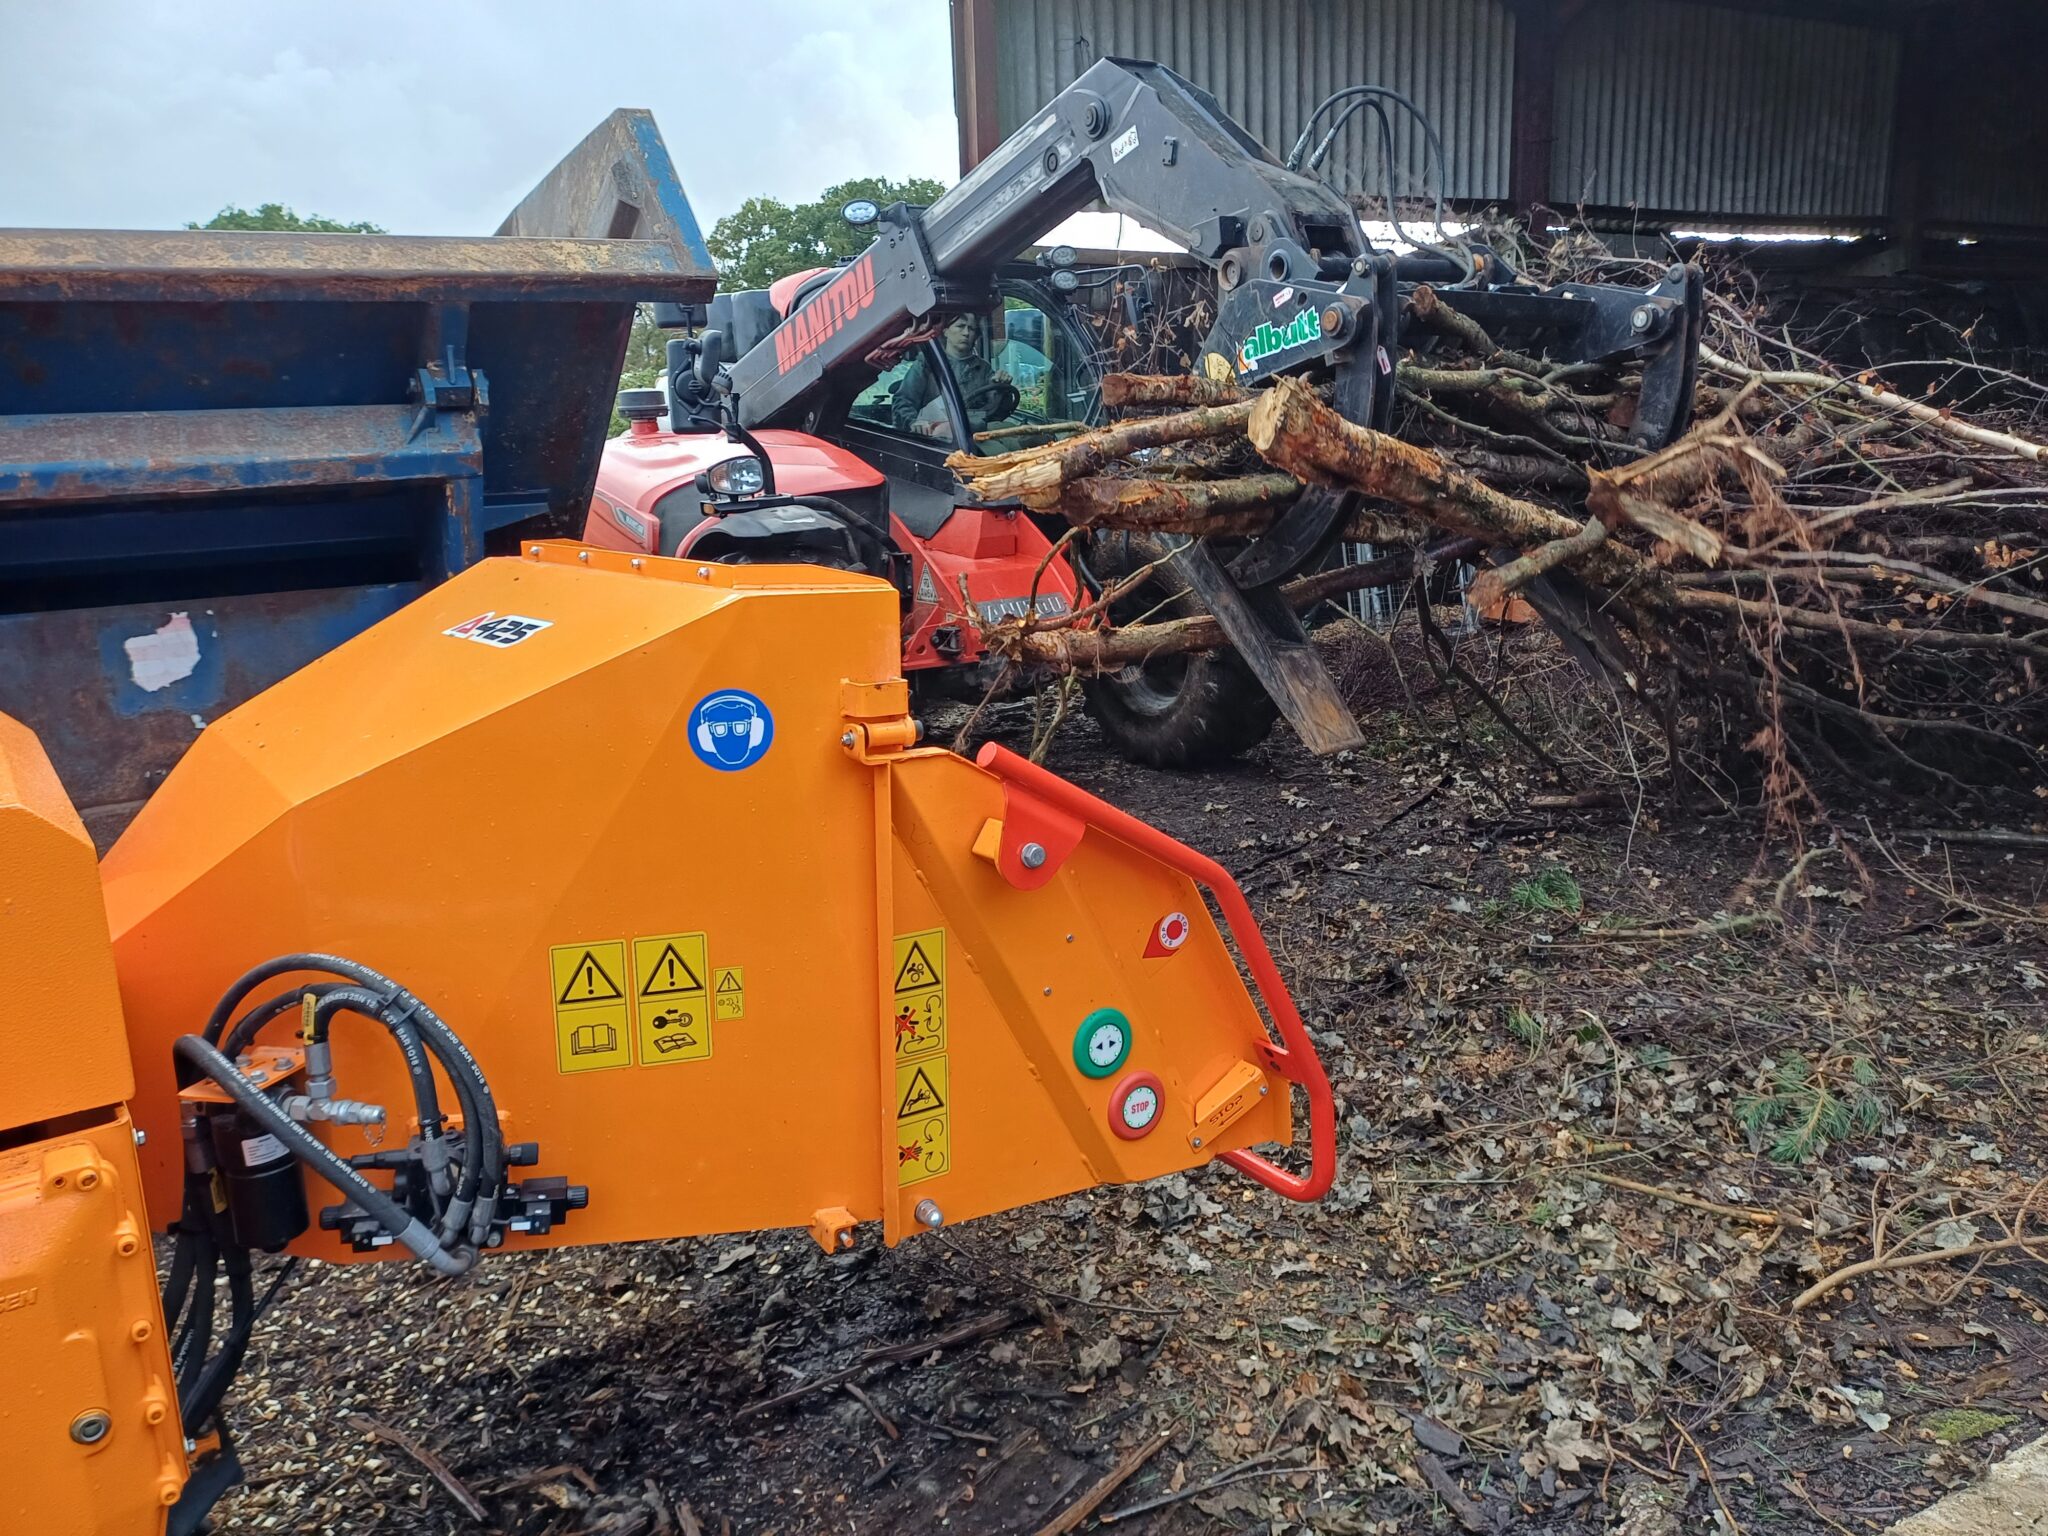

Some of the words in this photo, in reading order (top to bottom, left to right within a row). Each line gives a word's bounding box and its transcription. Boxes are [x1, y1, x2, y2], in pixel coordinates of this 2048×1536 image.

[774, 254, 876, 376] MANITOU
[1244, 307, 1321, 361] albutt
[396, 1027, 411, 1047] BAR
[435, 1019, 448, 1031] WP
[446, 1031, 459, 1044] 330
[458, 1045, 473, 1063] BAR
[1131, 1100, 1150, 1114] STOP
[1209, 1095, 1243, 1125] STOP
[311, 1139, 325, 1150] WP
[335, 1159, 352, 1175] BAR
